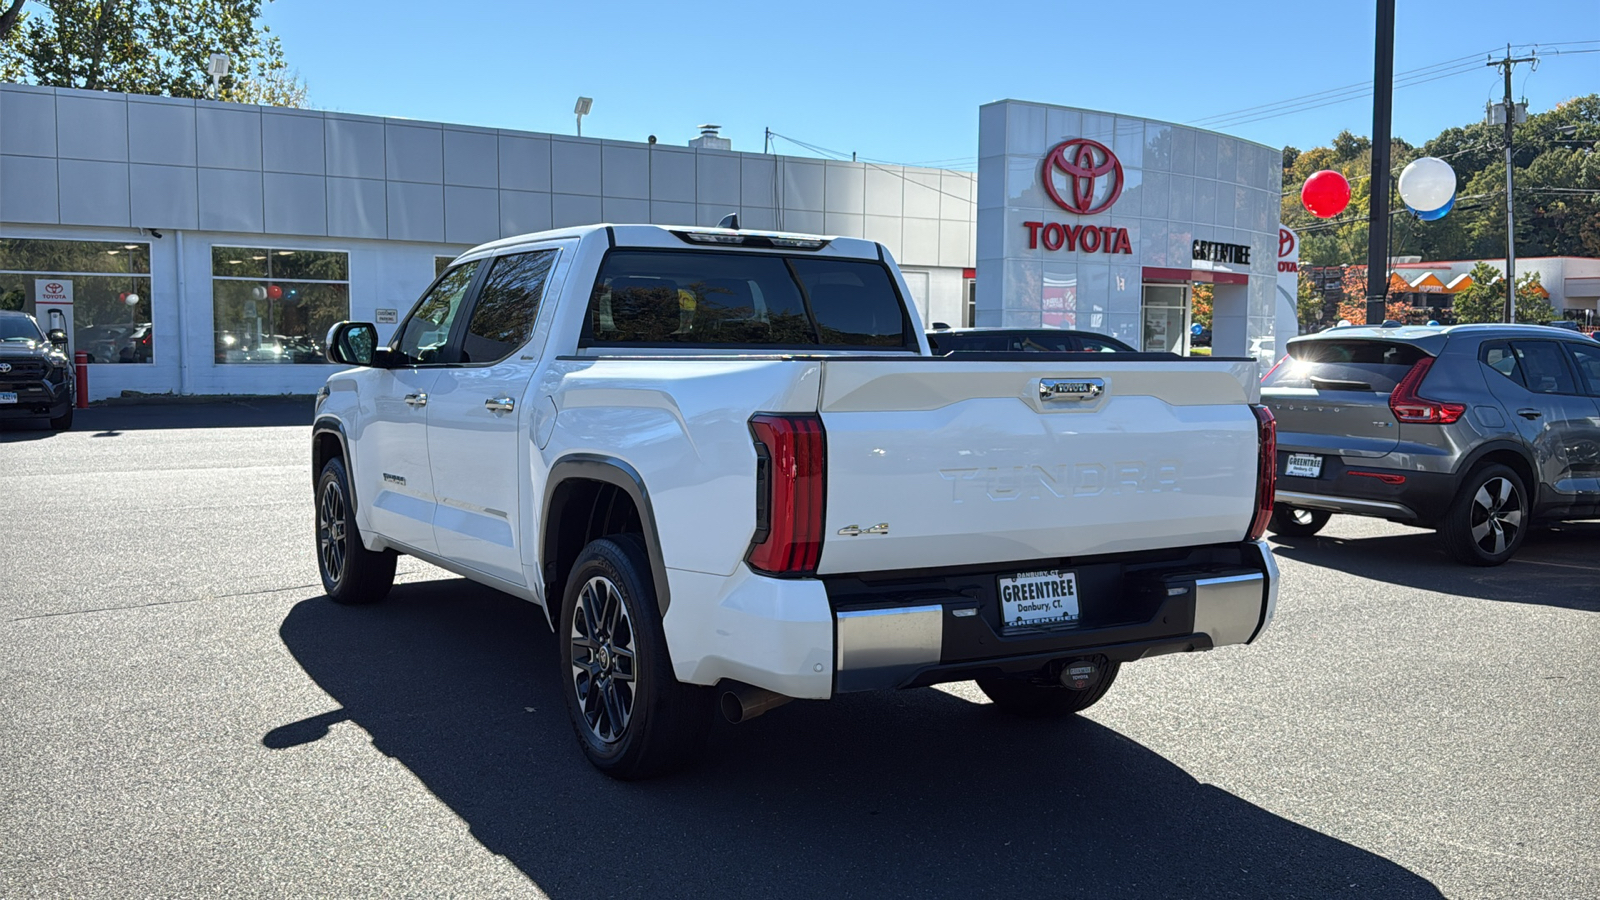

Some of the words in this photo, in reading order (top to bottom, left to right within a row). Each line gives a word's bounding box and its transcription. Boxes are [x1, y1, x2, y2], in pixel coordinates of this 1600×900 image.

[1023, 221, 1133, 254] TOYOTA
[1192, 239, 1251, 265] GREENTREE
[1418, 285, 1443, 293] NURSERY
[1058, 383, 1088, 393] TOYOTA
[1276, 404, 1340, 413] VOLVO
[1289, 457, 1321, 468] GREENTREE
[939, 460, 1183, 504] TUNDRA
[1003, 579, 1074, 602] GREENTREE
[1017, 601, 1051, 612] Danbury,
[1052, 600, 1063, 609] CT.
